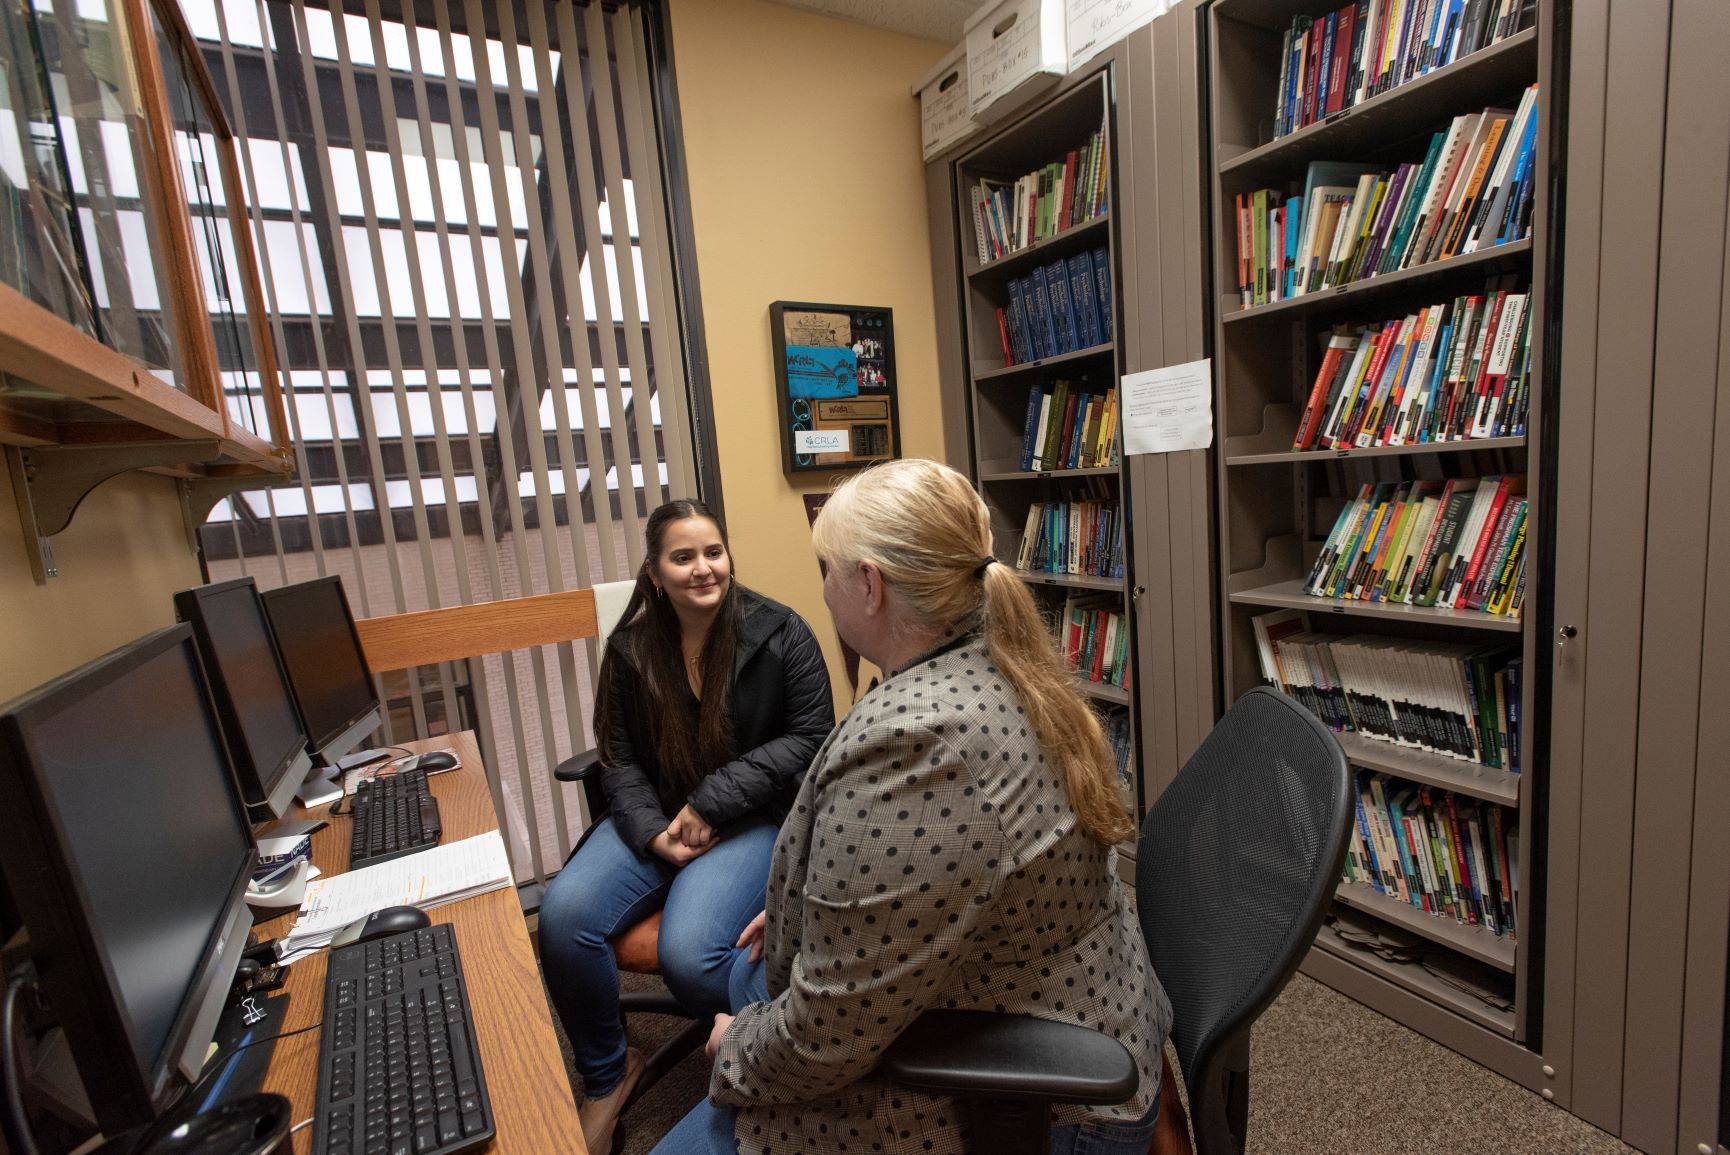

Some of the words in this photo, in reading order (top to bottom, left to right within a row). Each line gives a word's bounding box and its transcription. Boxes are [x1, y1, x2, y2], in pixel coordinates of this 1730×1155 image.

[1496, 336, 1504, 355] STUDENT
[815, 436, 839, 445] CRLA
[1512, 501, 1521, 513] THE
[1431, 517, 1448, 554] DEVELOPMENT
[1442, 519, 1456, 544] STUDENT
[1500, 513, 1516, 546] FRESHMAN
[1494, 546, 1504, 561] YEAR
[1507, 534, 1524, 561] Planning
